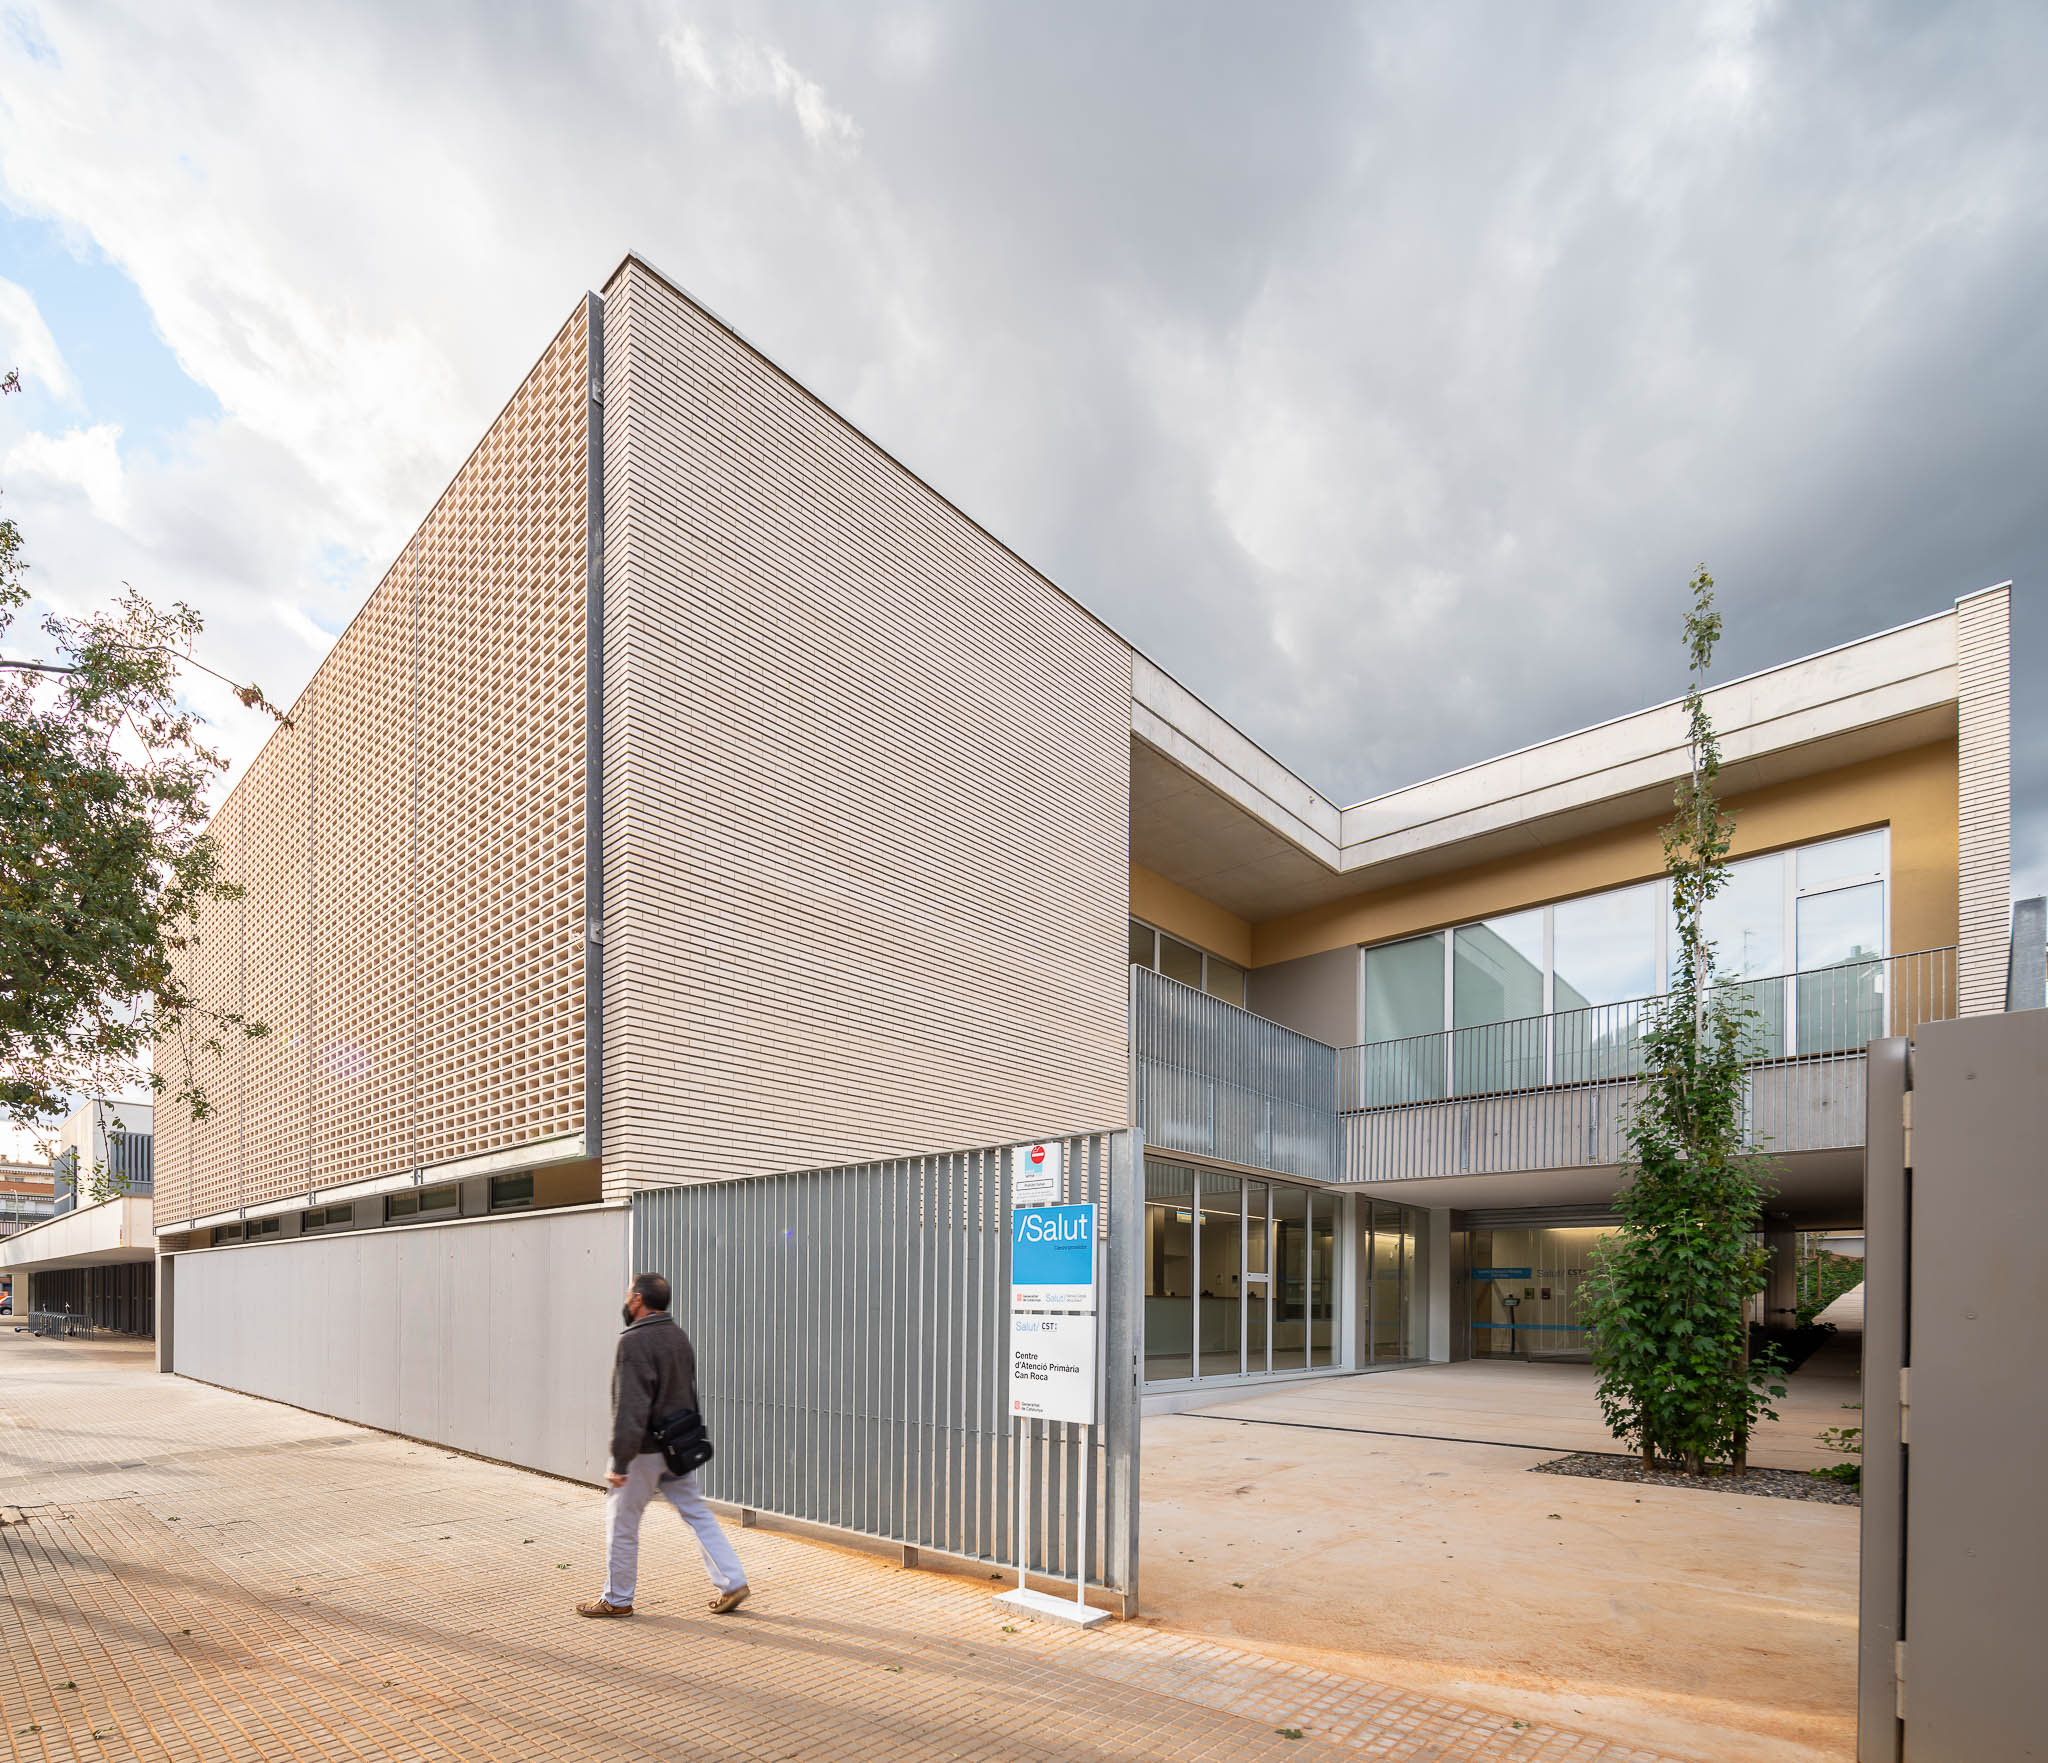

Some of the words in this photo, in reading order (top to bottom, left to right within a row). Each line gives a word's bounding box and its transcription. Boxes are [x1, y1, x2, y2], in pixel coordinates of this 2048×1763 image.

[1017, 1213, 1088, 1242] /Salut
[1015, 1351, 1038, 1360] Centre
[1015, 1361, 1048, 1371] d'Atenció
[1049, 1363, 1080, 1374] Primària
[1014, 1370, 1029, 1379] Can
[1030, 1372, 1048, 1381] Roca
